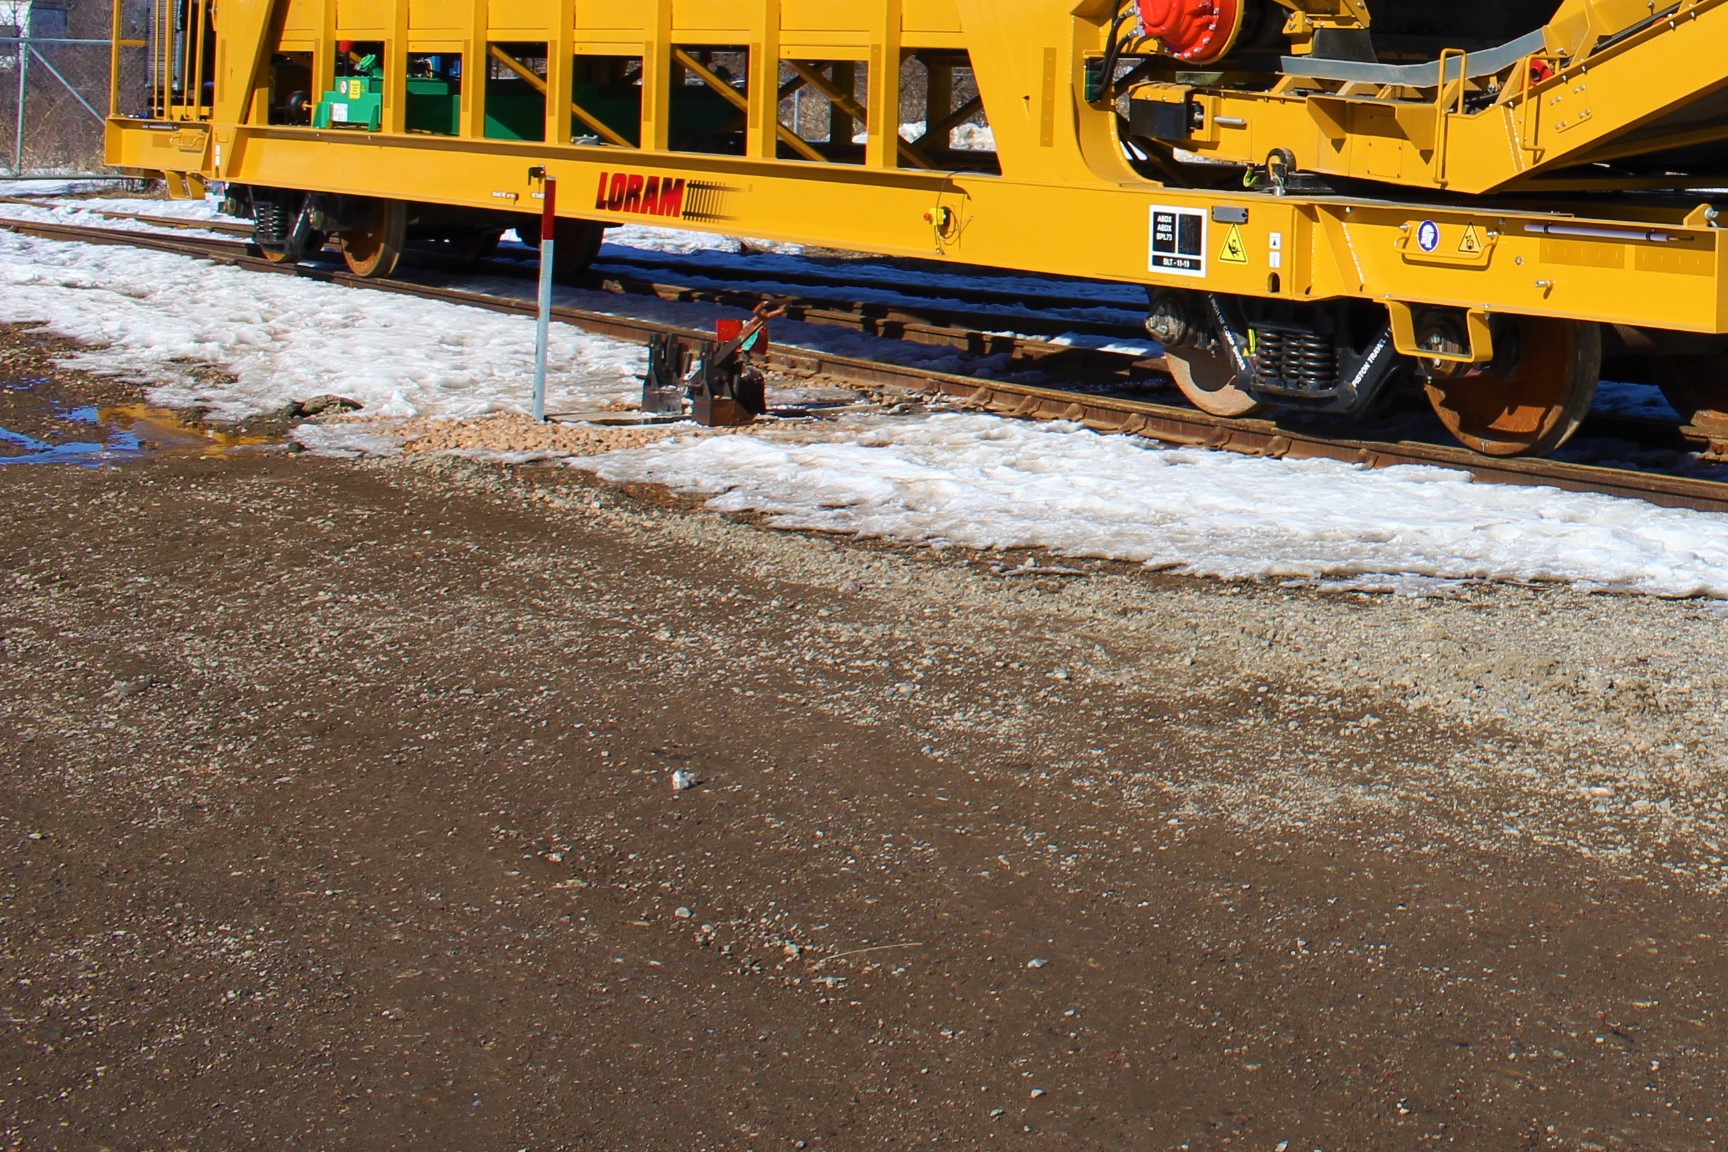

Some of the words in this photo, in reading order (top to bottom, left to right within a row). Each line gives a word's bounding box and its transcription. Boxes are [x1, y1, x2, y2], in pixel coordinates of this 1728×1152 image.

[595, 172, 686, 218] LORAM
[1163, 257, 1173, 266] BLT
[1351, 361, 1370, 387] PISTON
[1367, 337, 1387, 363] TRAVEL
